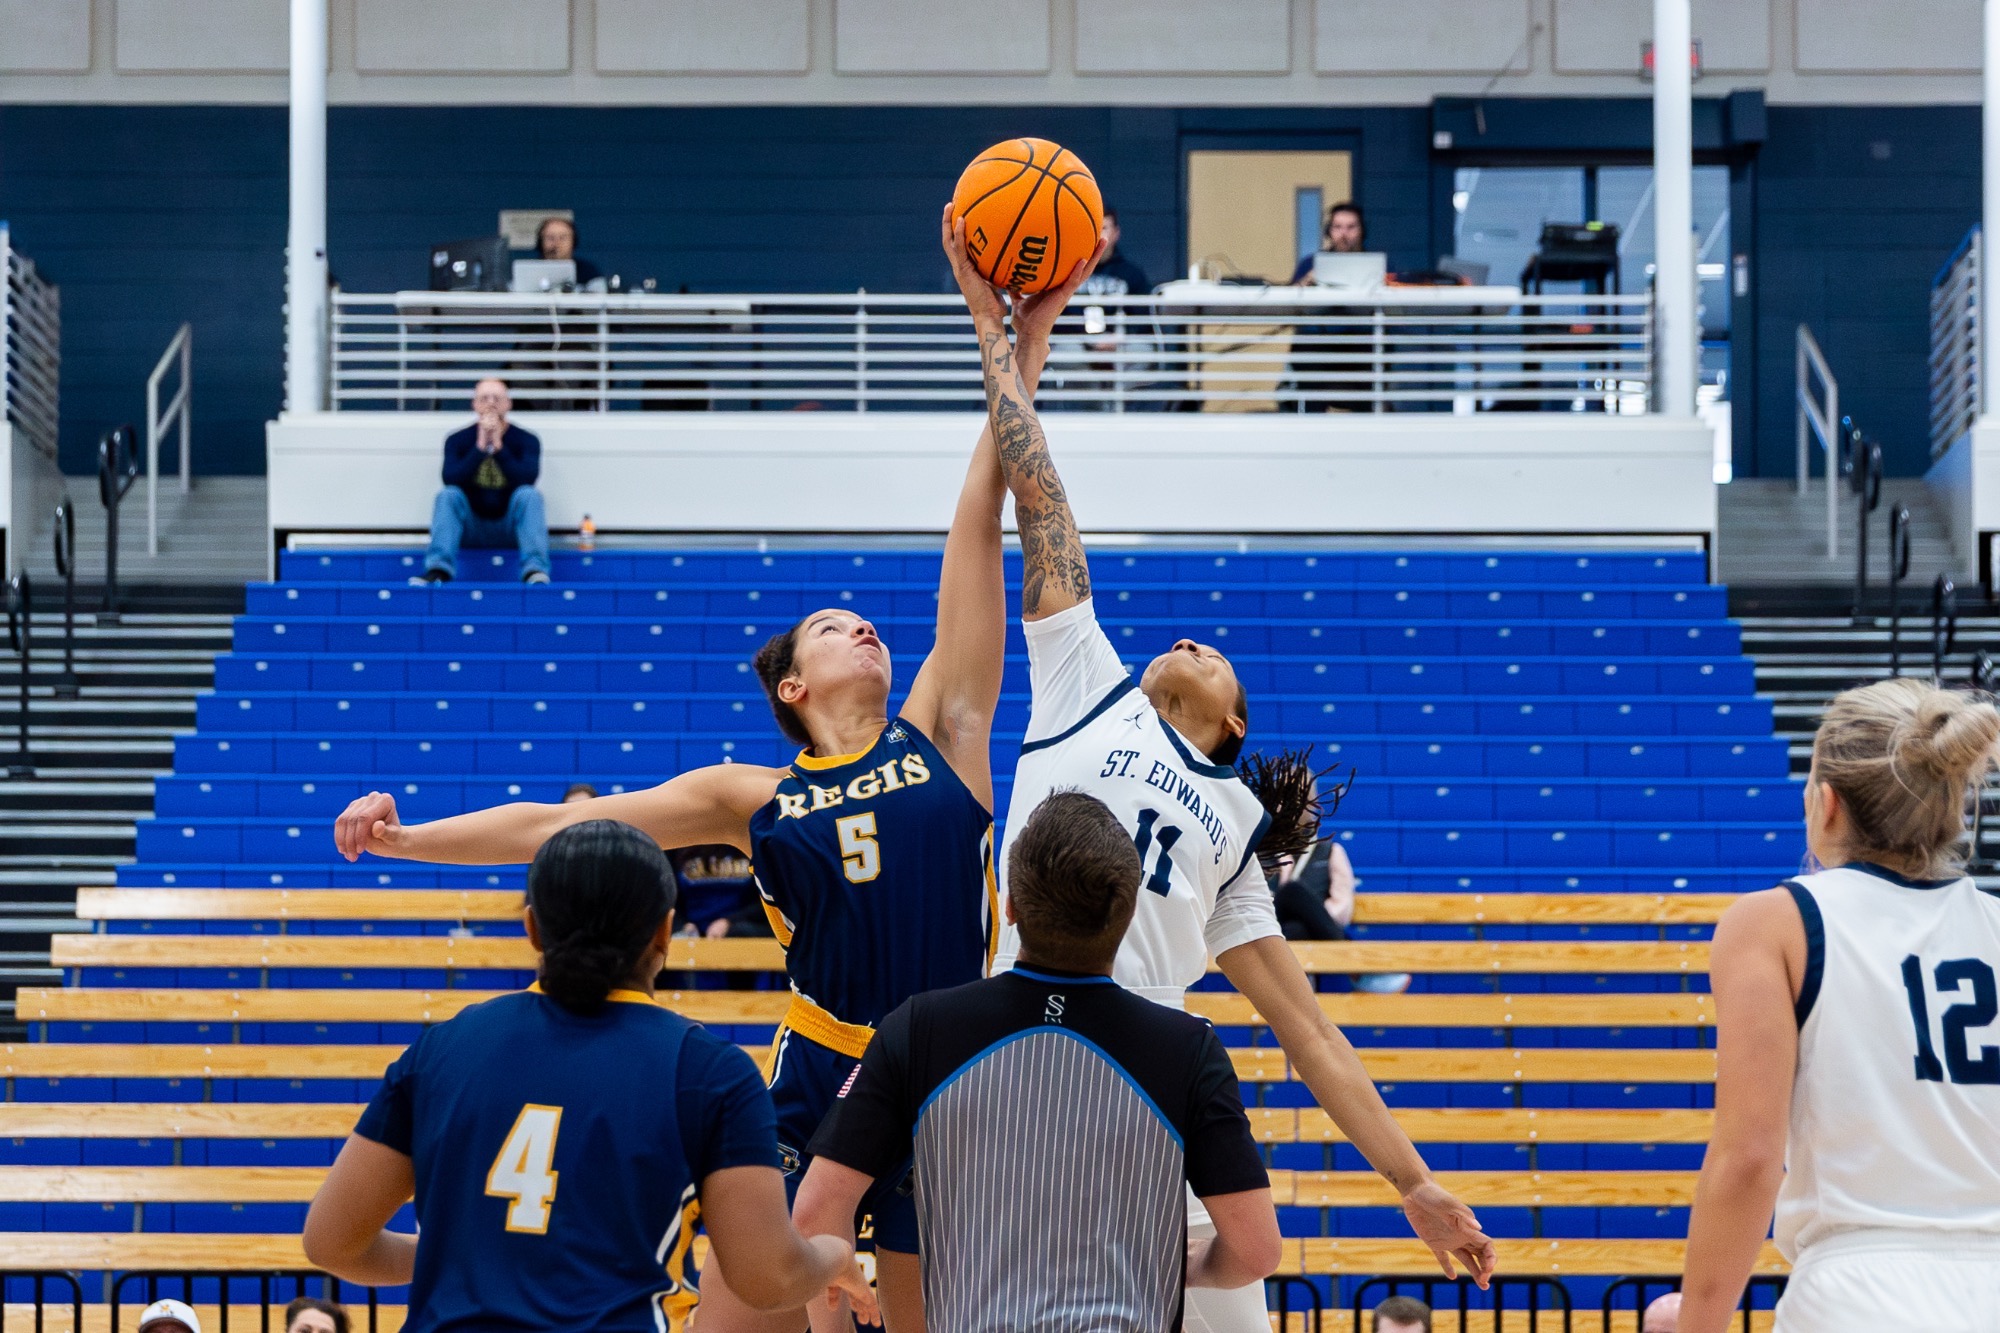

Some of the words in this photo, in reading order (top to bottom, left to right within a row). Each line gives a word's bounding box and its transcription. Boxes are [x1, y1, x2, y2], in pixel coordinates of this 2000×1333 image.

[776, 753, 931, 820] REGIS
[1100, 749, 1140, 778] ST.
[1145, 759, 1228, 865] EDWARD'S
[835, 811, 881, 884] 5
[1134, 808, 1183, 898] 11
[1901, 953, 2000, 1085] 12
[484, 1103, 564, 1235] 4
